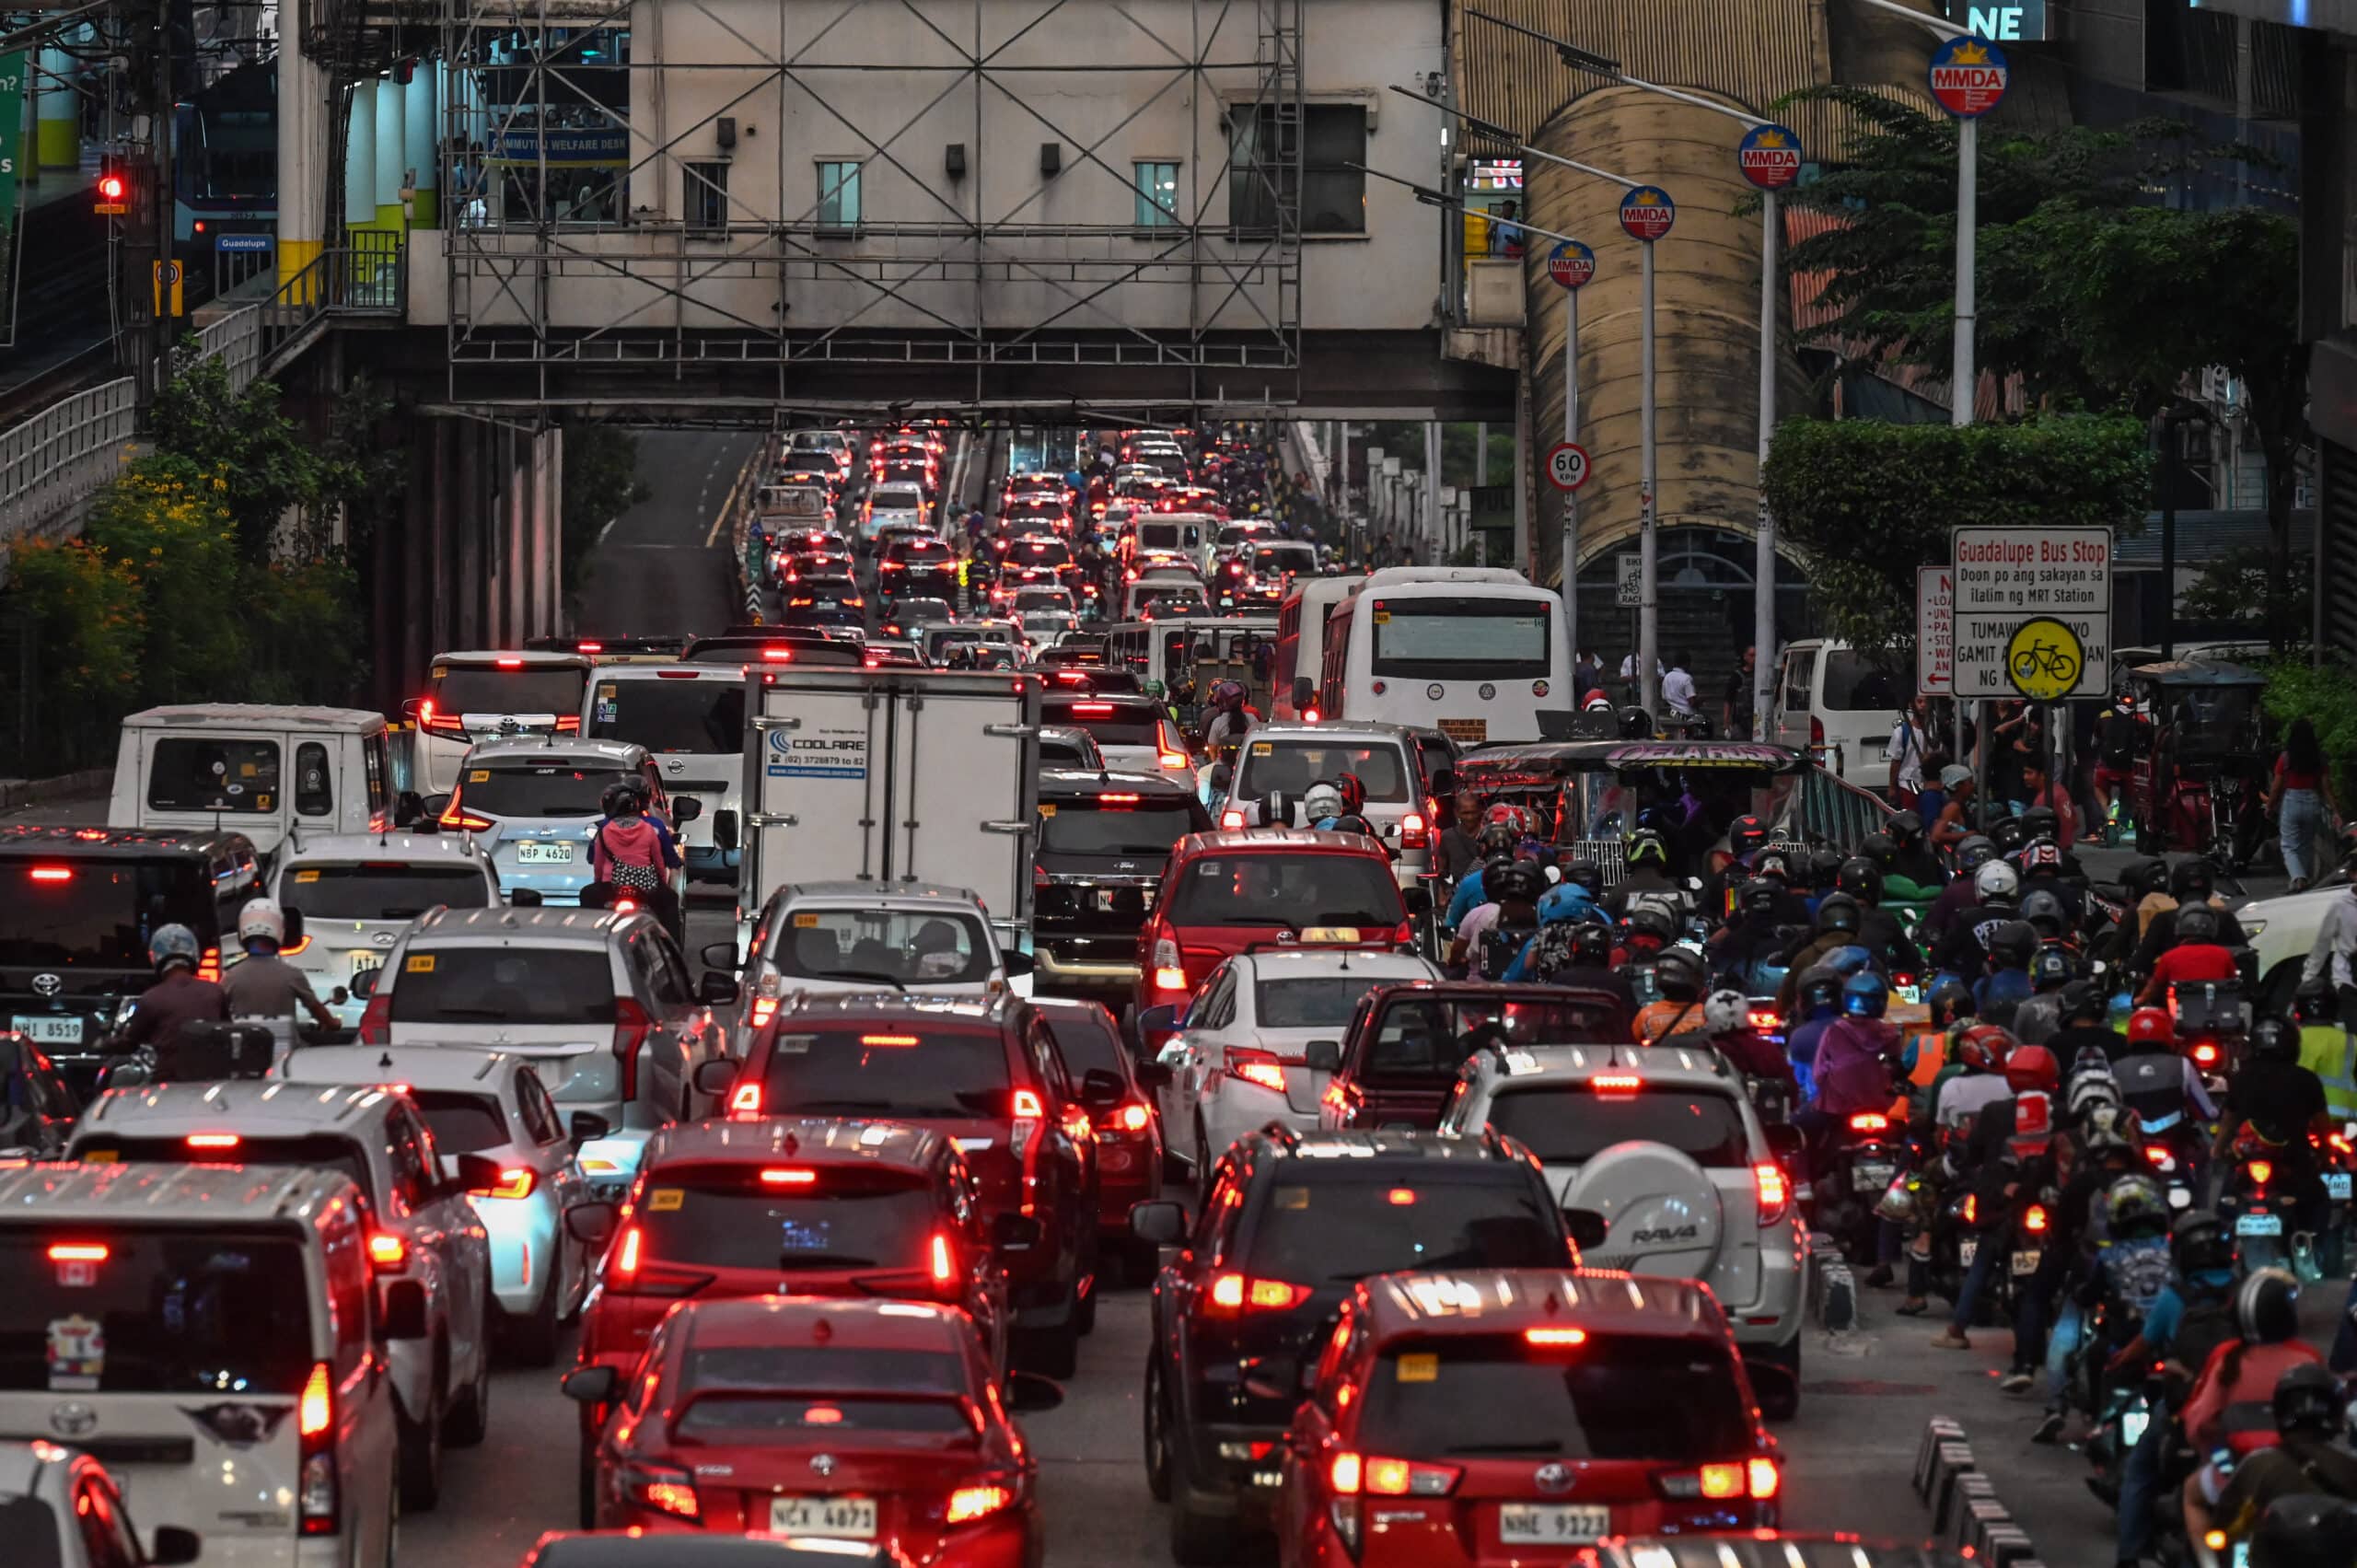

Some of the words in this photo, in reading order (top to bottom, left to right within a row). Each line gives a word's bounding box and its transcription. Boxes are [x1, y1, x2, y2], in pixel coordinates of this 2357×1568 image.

[1934, 69, 2002, 87] MMDA
[552, 140, 597, 150] WELFARE
[1744, 151, 1797, 166] MMDA
[1623, 208, 1669, 222] MMDA
[222, 239, 266, 248] Guadalupe
[1551, 261, 1591, 271] MMDA
[1556, 454, 1581, 472] 60
[1958, 540, 2034, 567] Guadalupe
[2041, 540, 2067, 563] Bus
[2073, 540, 2106, 567] Stop
[1960, 568, 1990, 582] Doon
[1995, 572, 2009, 585] po
[2014, 571, 2035, 586] ang
[2039, 568, 2086, 584] sakayan
[2091, 571, 2103, 582] sa
[1970, 589, 2004, 603] ilalim
[2009, 591, 2024, 605] ng
[2028, 589, 2050, 603] MRT
[2054, 589, 2095, 603] Station
[1934, 610, 1951, 620] UNL
[1934, 621, 1950, 632] PA
[1957, 646, 1997, 662] GAMIT
[1980, 670, 1997, 686] NG
[793, 739, 865, 750] COOLAIRE
[785, 756, 801, 764] (02)
[842, 757, 851, 765] to
[853, 757, 865, 765] 82
[520, 848, 539, 858] NBP
[545, 849, 570, 860] 4620
[47, 1023, 79, 1038] 8519
[1631, 1225, 1698, 1243] RAV4
[1554, 1516, 1605, 1537] 9123
